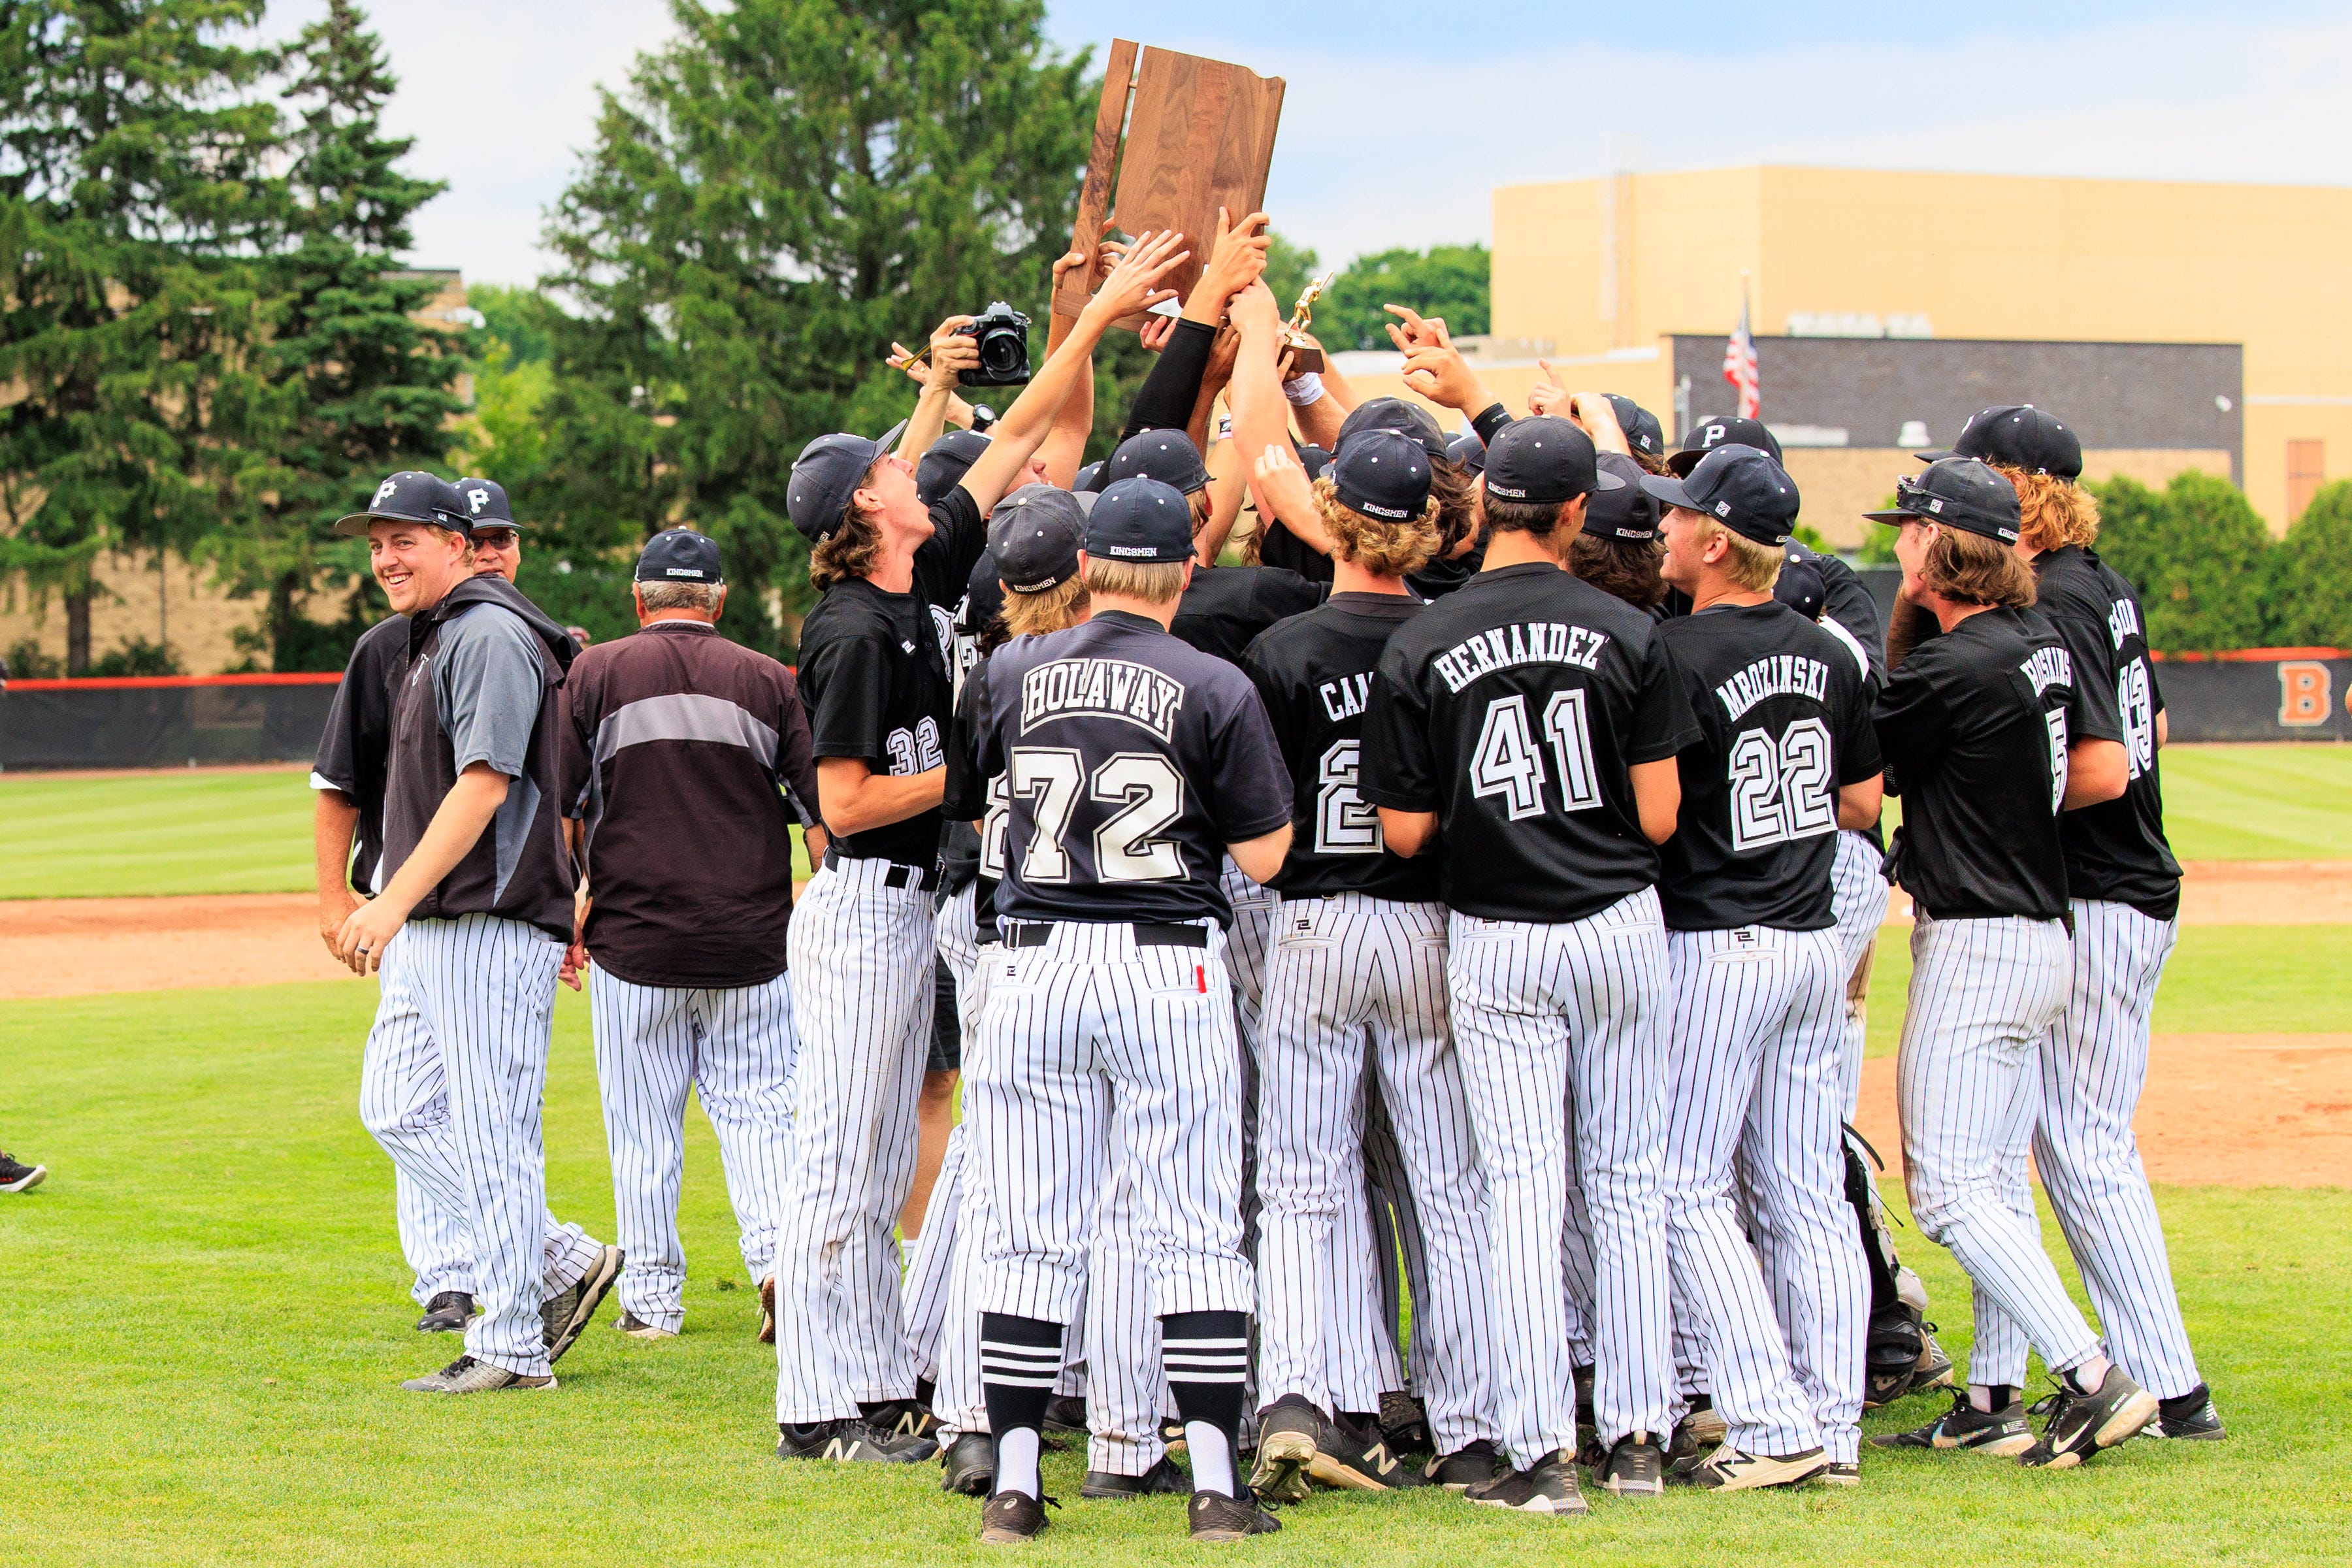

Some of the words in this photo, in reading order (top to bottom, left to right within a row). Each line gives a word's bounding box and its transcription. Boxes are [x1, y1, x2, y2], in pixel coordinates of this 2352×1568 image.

[1362, 502, 1408, 518] KINGSMEN
[1488, 481, 1526, 498] KINGSMEN
[1110, 546, 1157, 556] KINGSMEN
[1616, 527, 1653, 538] KINGSMEN
[666, 568, 704, 578] KINGSMEN
[1013, 577, 1057, 592] KINGSMEN
[1433, 622, 1610, 694] HERNANDEZ
[1716, 655, 1831, 723] MROZINSKI
[2019, 646, 2072, 698] HOSKINS
[1021, 658, 1184, 744] HOLAWAY
[2278, 661, 2332, 727] B
[885, 715, 946, 777] 32
[1470, 688, 1603, 821] 41
[1011, 746, 1190, 883] 72
[1729, 717, 1838, 851] 22
